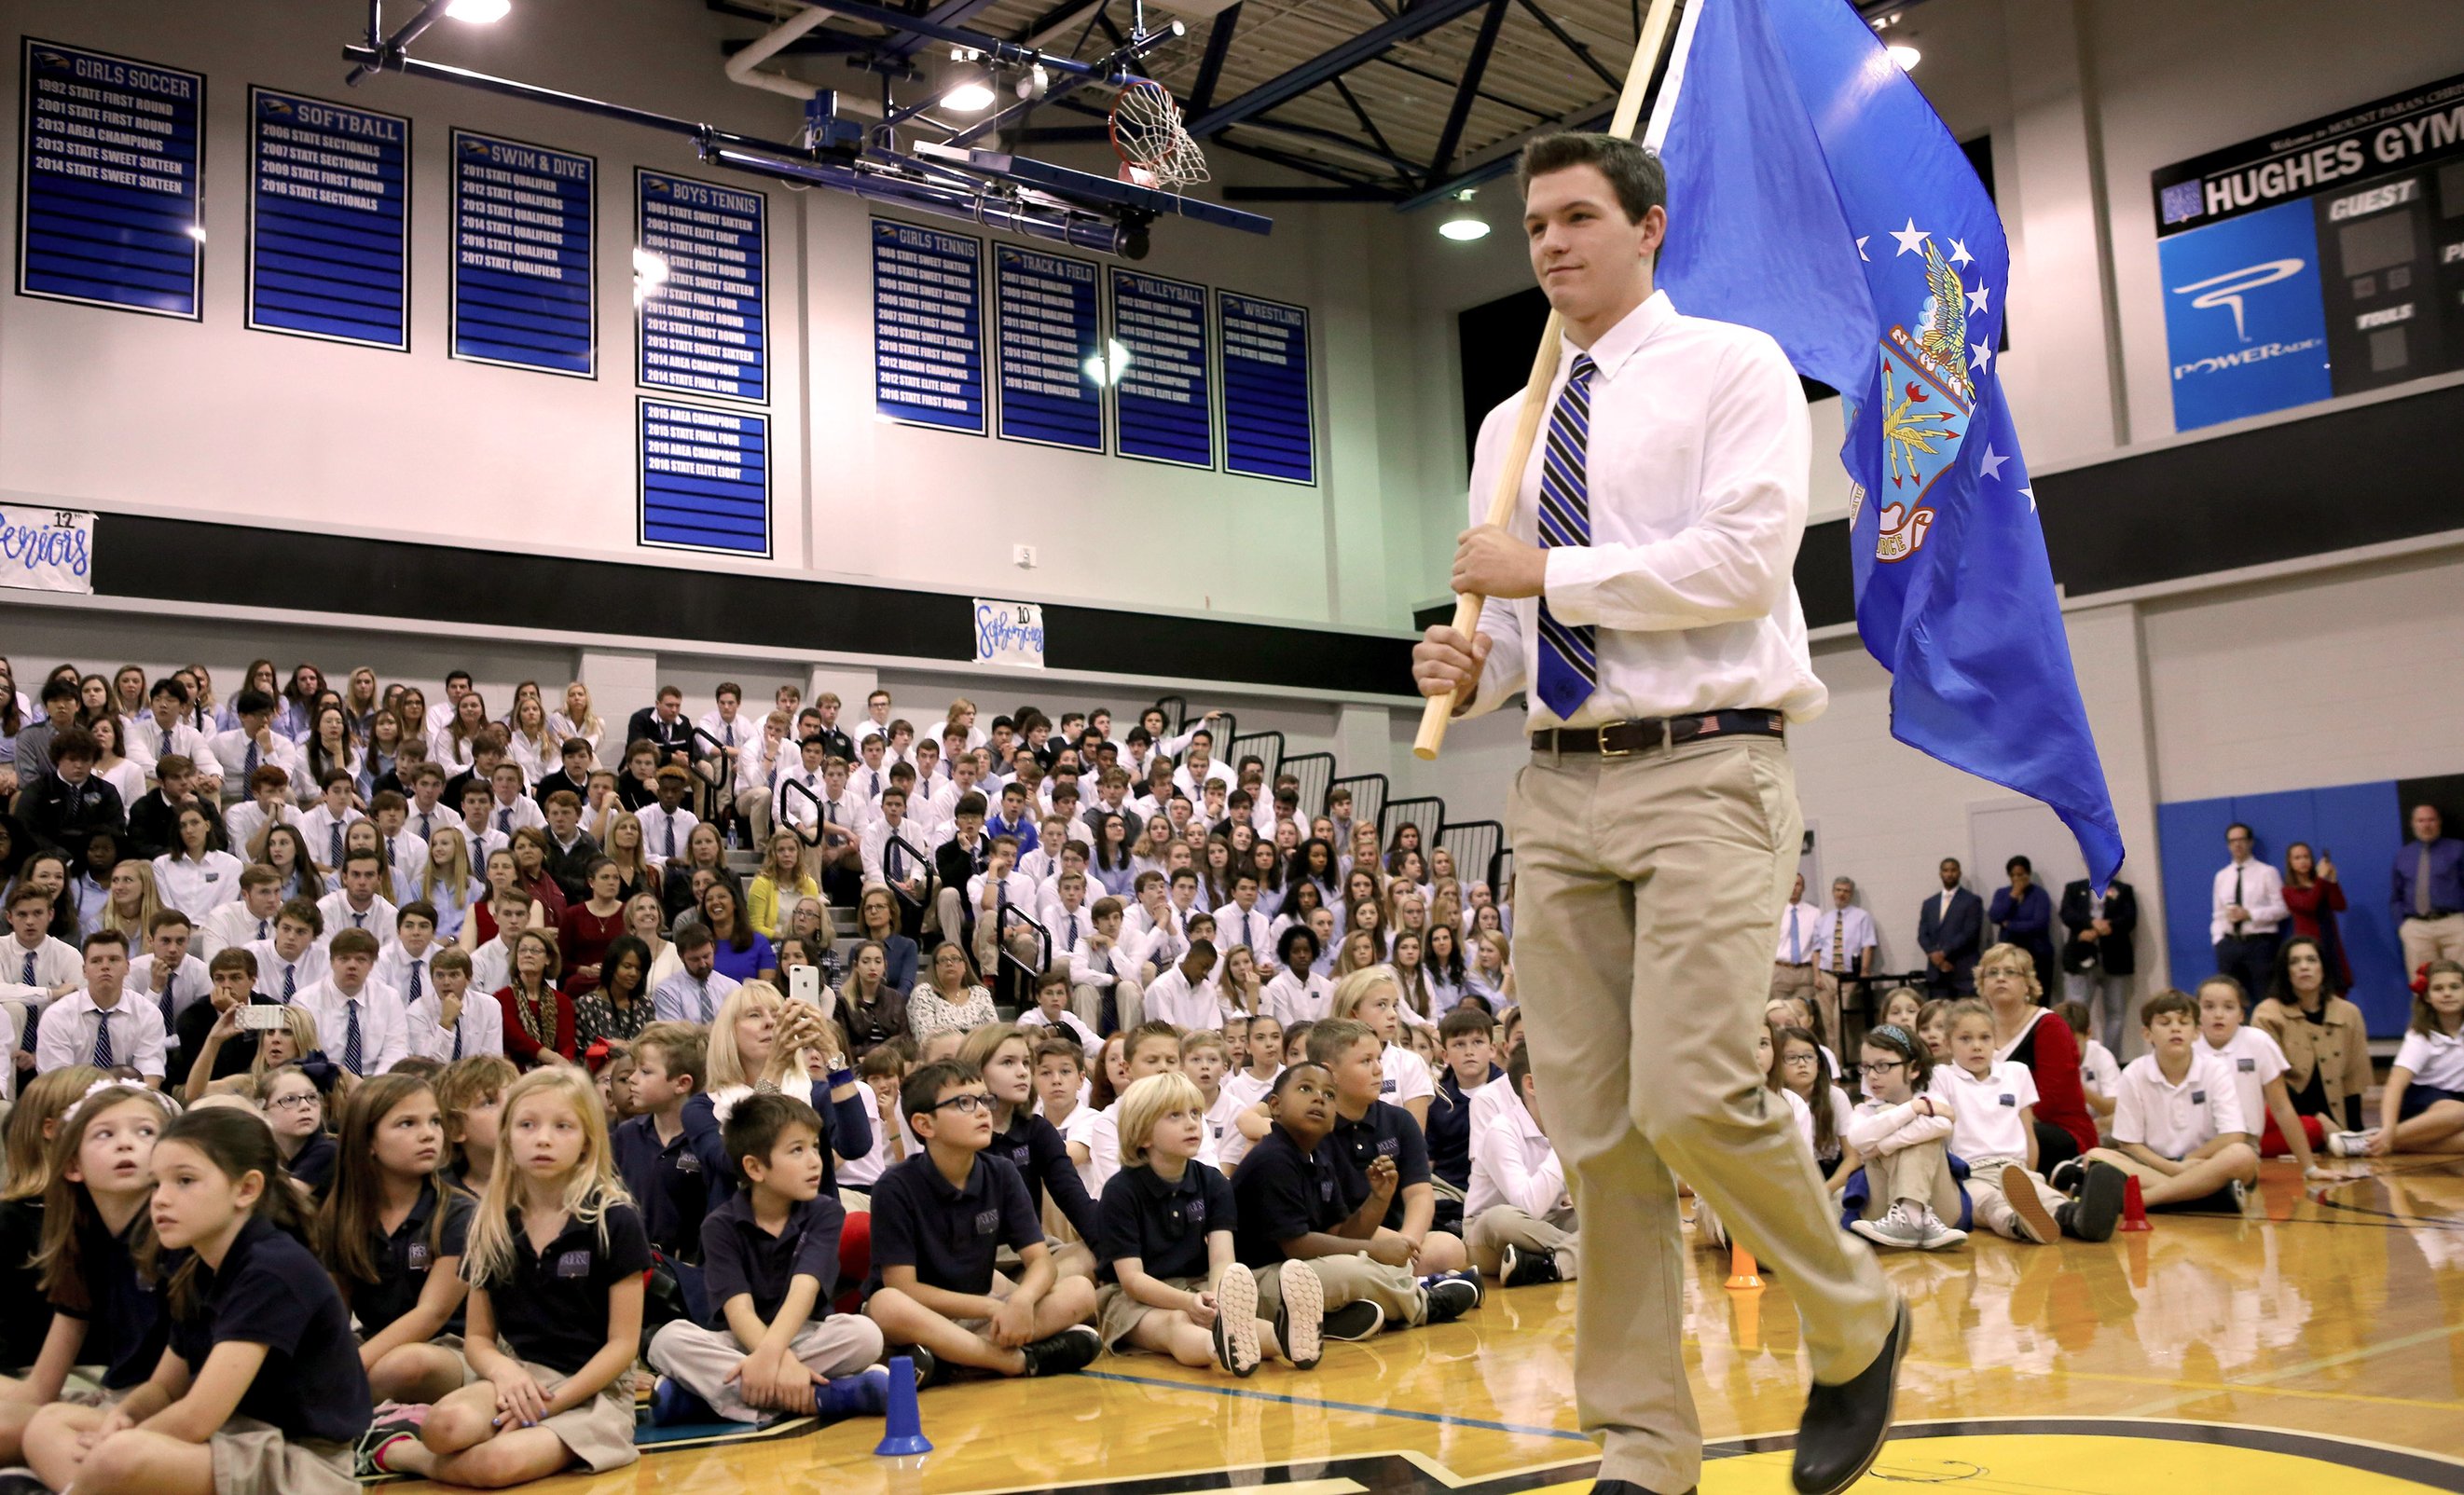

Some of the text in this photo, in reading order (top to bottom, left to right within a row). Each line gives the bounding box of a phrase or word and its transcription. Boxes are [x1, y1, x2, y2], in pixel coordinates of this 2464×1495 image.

[76, 59, 190, 99] GIRLS SOCCER
[37, 78, 173, 117] 1992 STATE FIRST ROUND
[37, 98, 173, 135] 2001 STATE FIRST ROUND
[298, 104, 398, 141] SOFTBALL
[36, 117, 164, 152] 2013 AREA CHAMPIONS
[291, 130, 321, 145] STATE
[322, 135, 380, 158] SECTIONALS
[36, 137, 183, 175] 2013 STATE SWEET SIXTEEN
[262, 143, 379, 175] 2007 STATE SECTIONALS
[491, 145, 585, 179] SWIM & DIVE
[2206, 139, 2364, 215] HUGHES
[2374, 105, 2464, 163] GYM
[36, 157, 183, 194] 2014 STATE SWEET SIXTEEN
[291, 166, 320, 182] STATE
[321, 171, 349, 187] FIRST
[351, 176, 384, 194] ROUND
[463, 164, 557, 192] 2011 STATE QUALIFIER
[288, 184, 318, 199] STATE
[319, 189, 378, 211] SECTIONALS
[462, 182, 563, 211] 2012 STATE QUALIFIERS
[673, 184, 756, 213] BOYS TENNIS
[2329, 178, 2416, 222] GUEST
[462, 199, 563, 227] 2013 STATE QUALIFIERS
[668, 205, 692, 219] STATE
[694, 210, 720, 225] SWEET
[721, 215, 752, 231] SIXTEEN
[462, 216, 563, 244] 2014 STATE QUALIFIERS
[669, 222, 694, 237] STATE
[695, 226, 715, 240] ELITE
[715, 230, 738, 245] EIGHT
[900, 229, 975, 257] GIRLS TENNIS
[487, 238, 513, 254] STATE
[514, 242, 558, 261] QUALIFIER
[669, 239, 693, 253] STATE
[694, 243, 717, 257] FIRST
[718, 247, 746, 263] ROUND
[462, 252, 562, 279] 2017 STATE QUALIFIERS
[670, 255, 694, 269] STATE
[695, 259, 717, 273] FIRST
[718, 263, 746, 278] ROUND
[1022, 254, 1093, 281] TRACK & FIELD
[670, 272, 694, 287] STATE
[695, 277, 722, 292] SWEET
[723, 281, 754, 296] SIXTEEN
[1136, 279, 1201, 304] VOLLEYBALL
[668, 289, 693, 303] STATE
[694, 293, 715, 307] FINAL
[716, 296, 737, 310] FOUR
[647, 302, 744, 328] 2011 STATE FIRST ROUND
[1243, 302, 1301, 325] WRESTLING
[2356, 302, 2415, 330] FOULS
[647, 319, 746, 344] 2012 STATE FIRST ROUND
[647, 336, 754, 363] 2013 STATE SWEET SIXTEEN
[648, 352, 739, 377] 2014 AREA CHAMPIONS
[648, 370, 738, 393] 2014 STATE FINAL FOUR
[648, 406, 740, 430] 2015 AREA CHAMPIONS
[648, 423, 739, 446] 2015 STATE FINAL FOUR
[670, 444, 692, 457] AREA
[692, 446, 741, 463] CHAMPIONS
[670, 460, 695, 474] STATE
[695, 463, 716, 476] ELITE
[717, 466, 741, 480] EIGHT
[0, 513, 89, 576] eniors
[1017, 605, 1030, 624] 10
